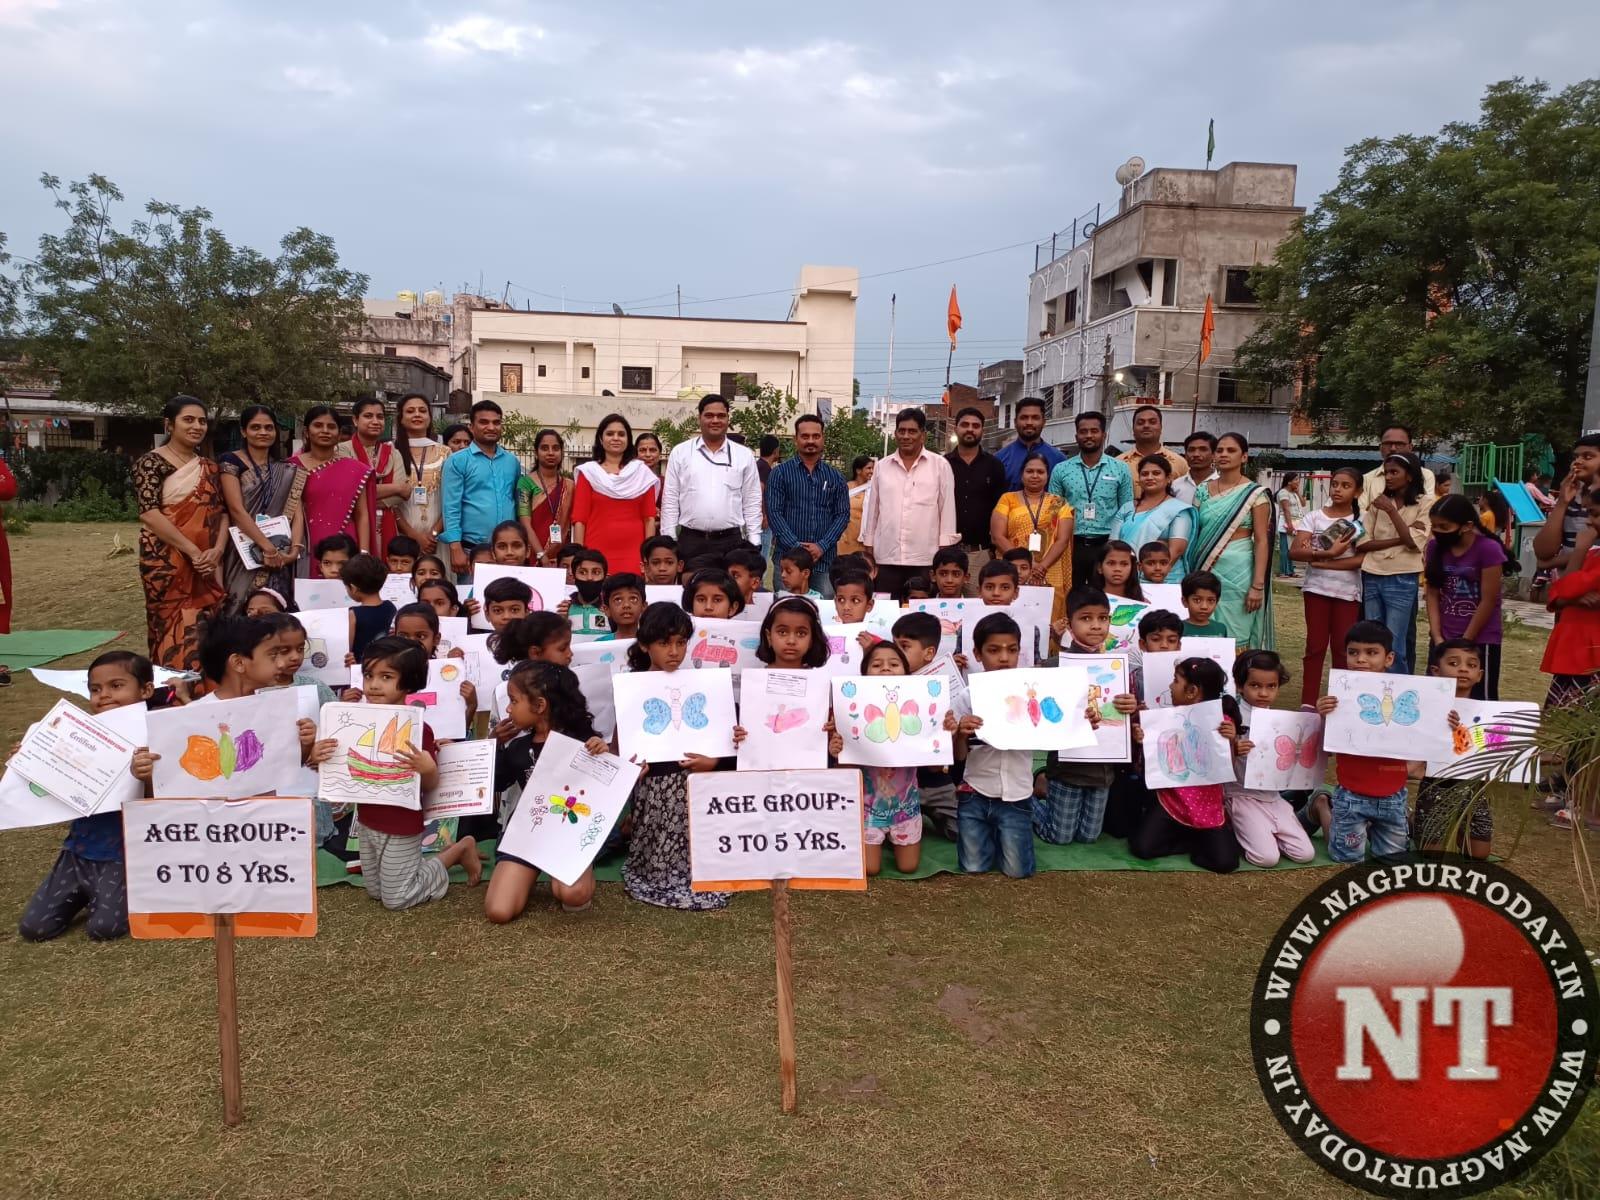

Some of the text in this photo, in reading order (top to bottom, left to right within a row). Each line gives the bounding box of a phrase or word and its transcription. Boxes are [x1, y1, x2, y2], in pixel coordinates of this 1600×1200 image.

[706, 795, 757, 815] AGE
[763, 792, 855, 813] GROUP:-
[143, 822, 306, 843] AGE GROUP:-
[718, 829, 846, 854] 3 TO 5 YRS.
[156, 860, 295, 885] 6 TO 8 YRS.
